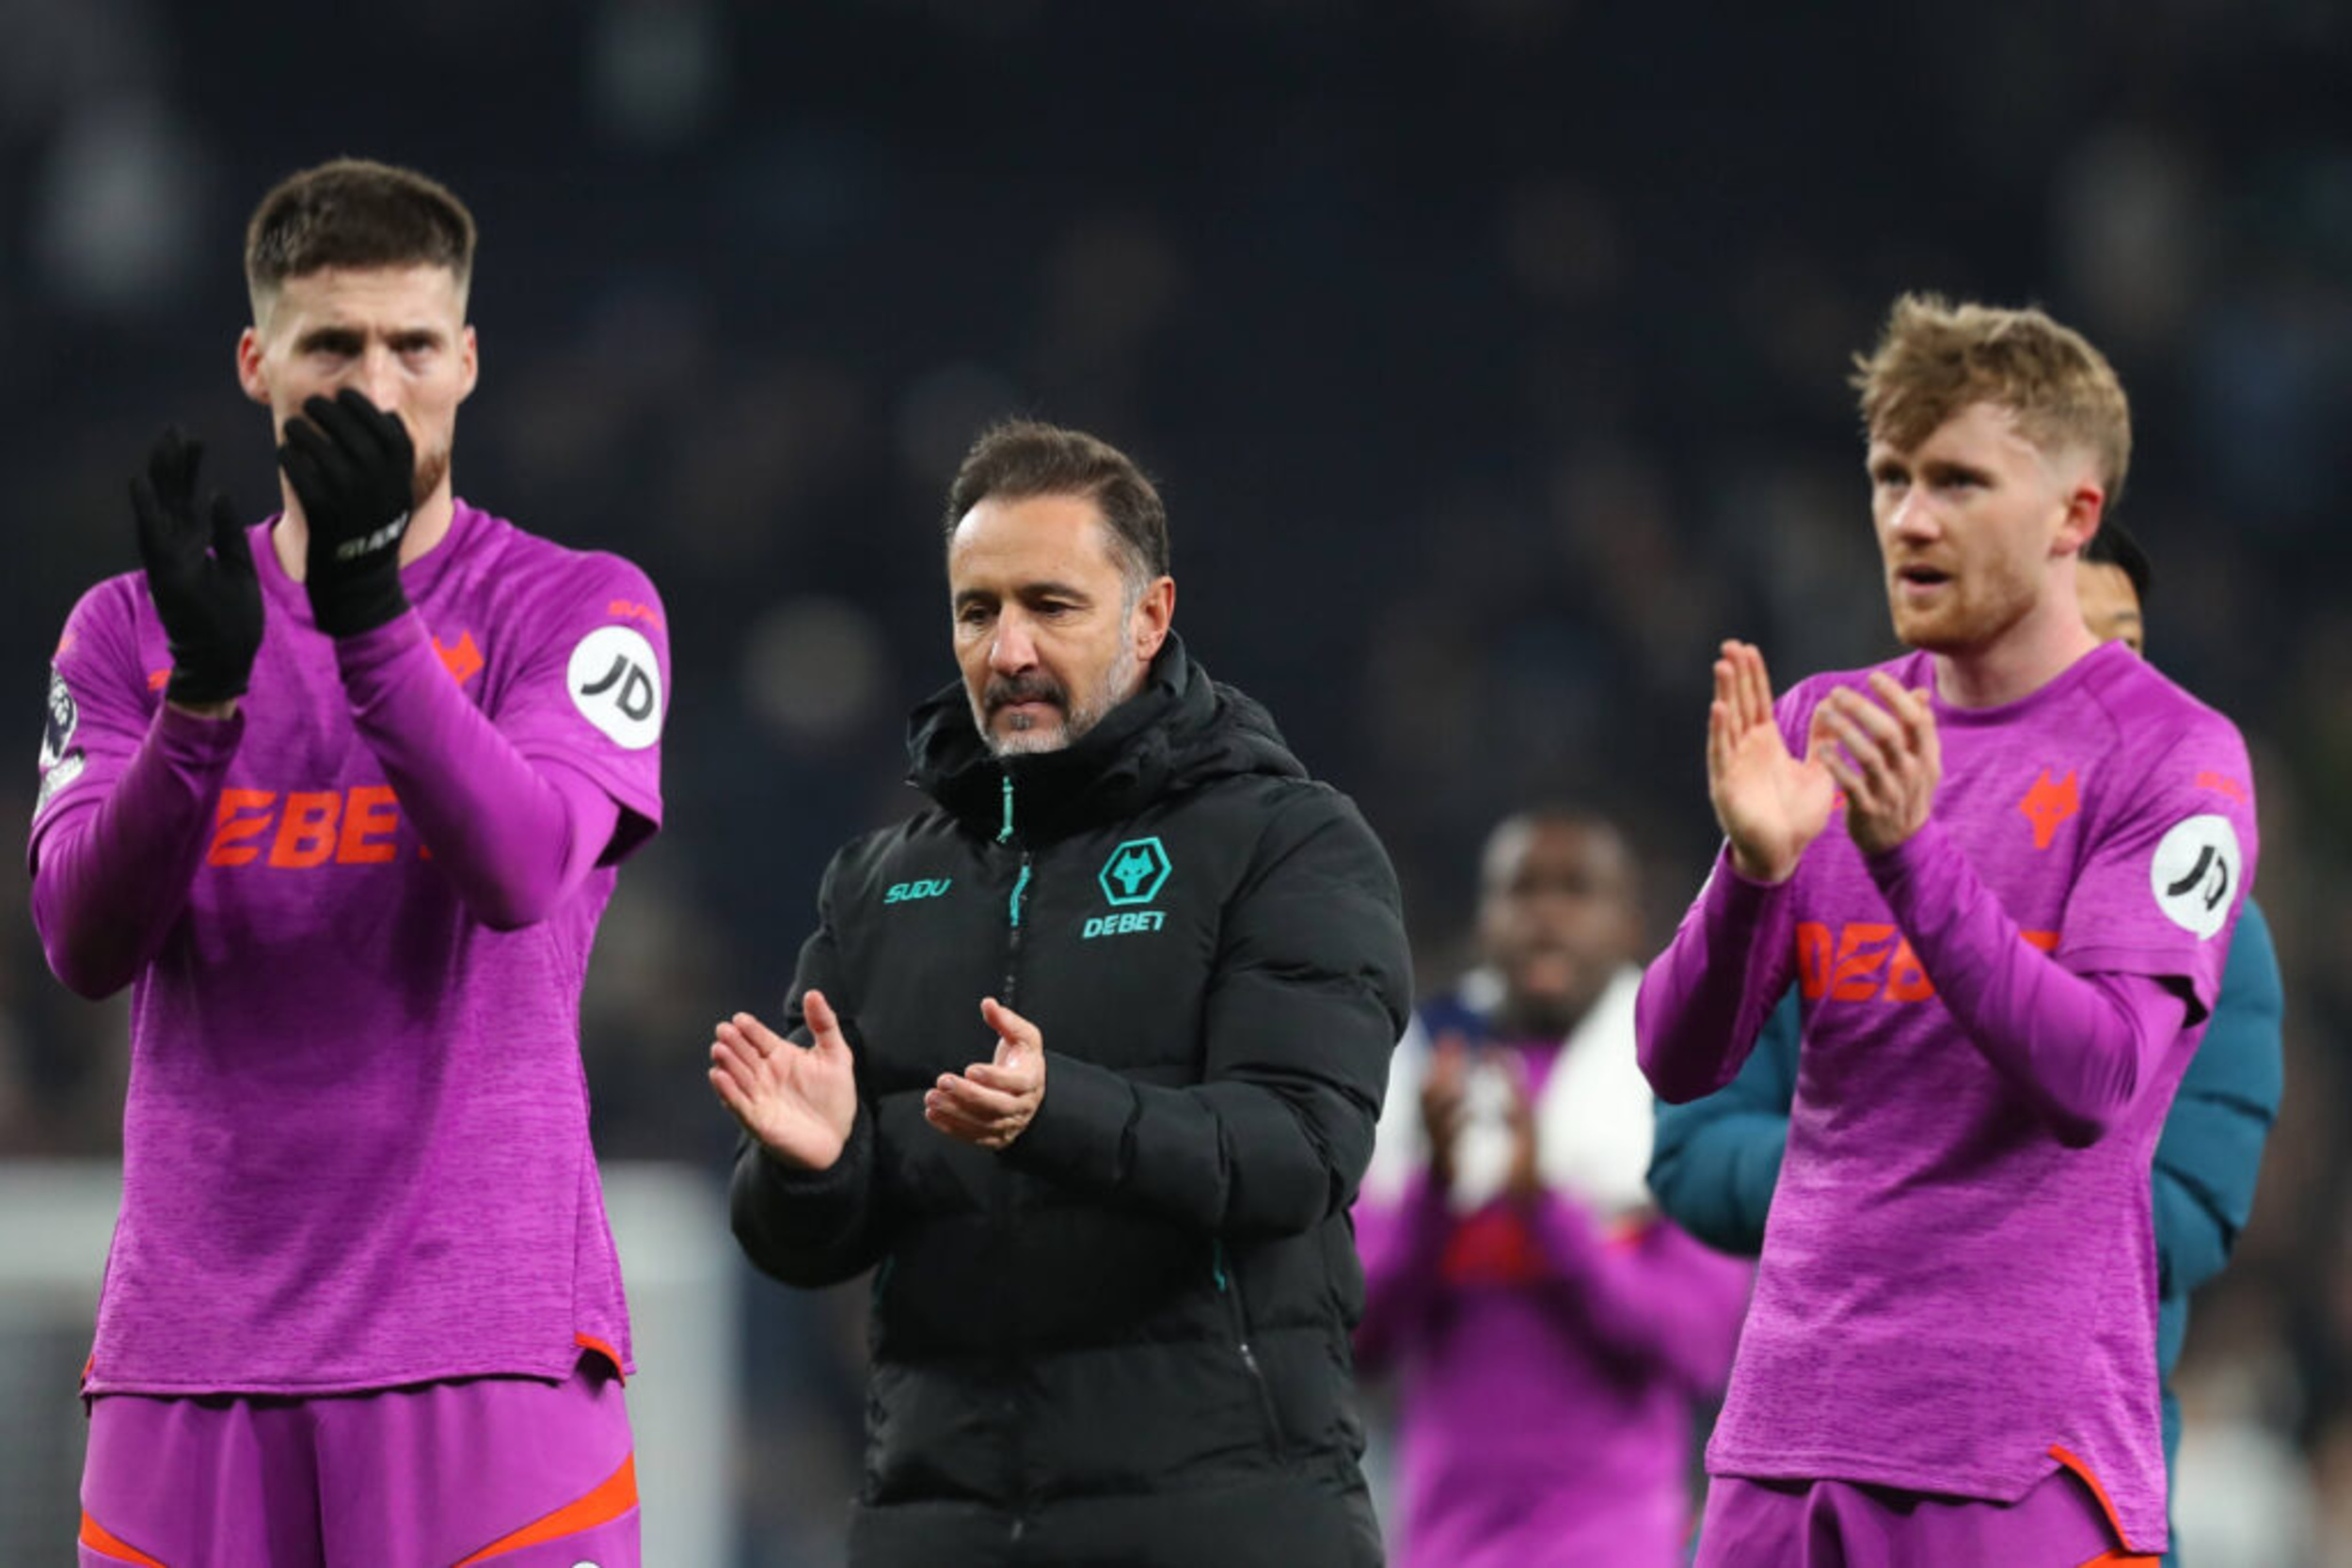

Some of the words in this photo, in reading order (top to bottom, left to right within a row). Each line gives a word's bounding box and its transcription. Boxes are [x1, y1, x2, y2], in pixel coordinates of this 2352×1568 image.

[580, 653, 656, 722] JD
[205, 784, 431, 869] EBE
[882, 878, 952, 904] SUDU
[1082, 911, 1168, 940] DEBET
